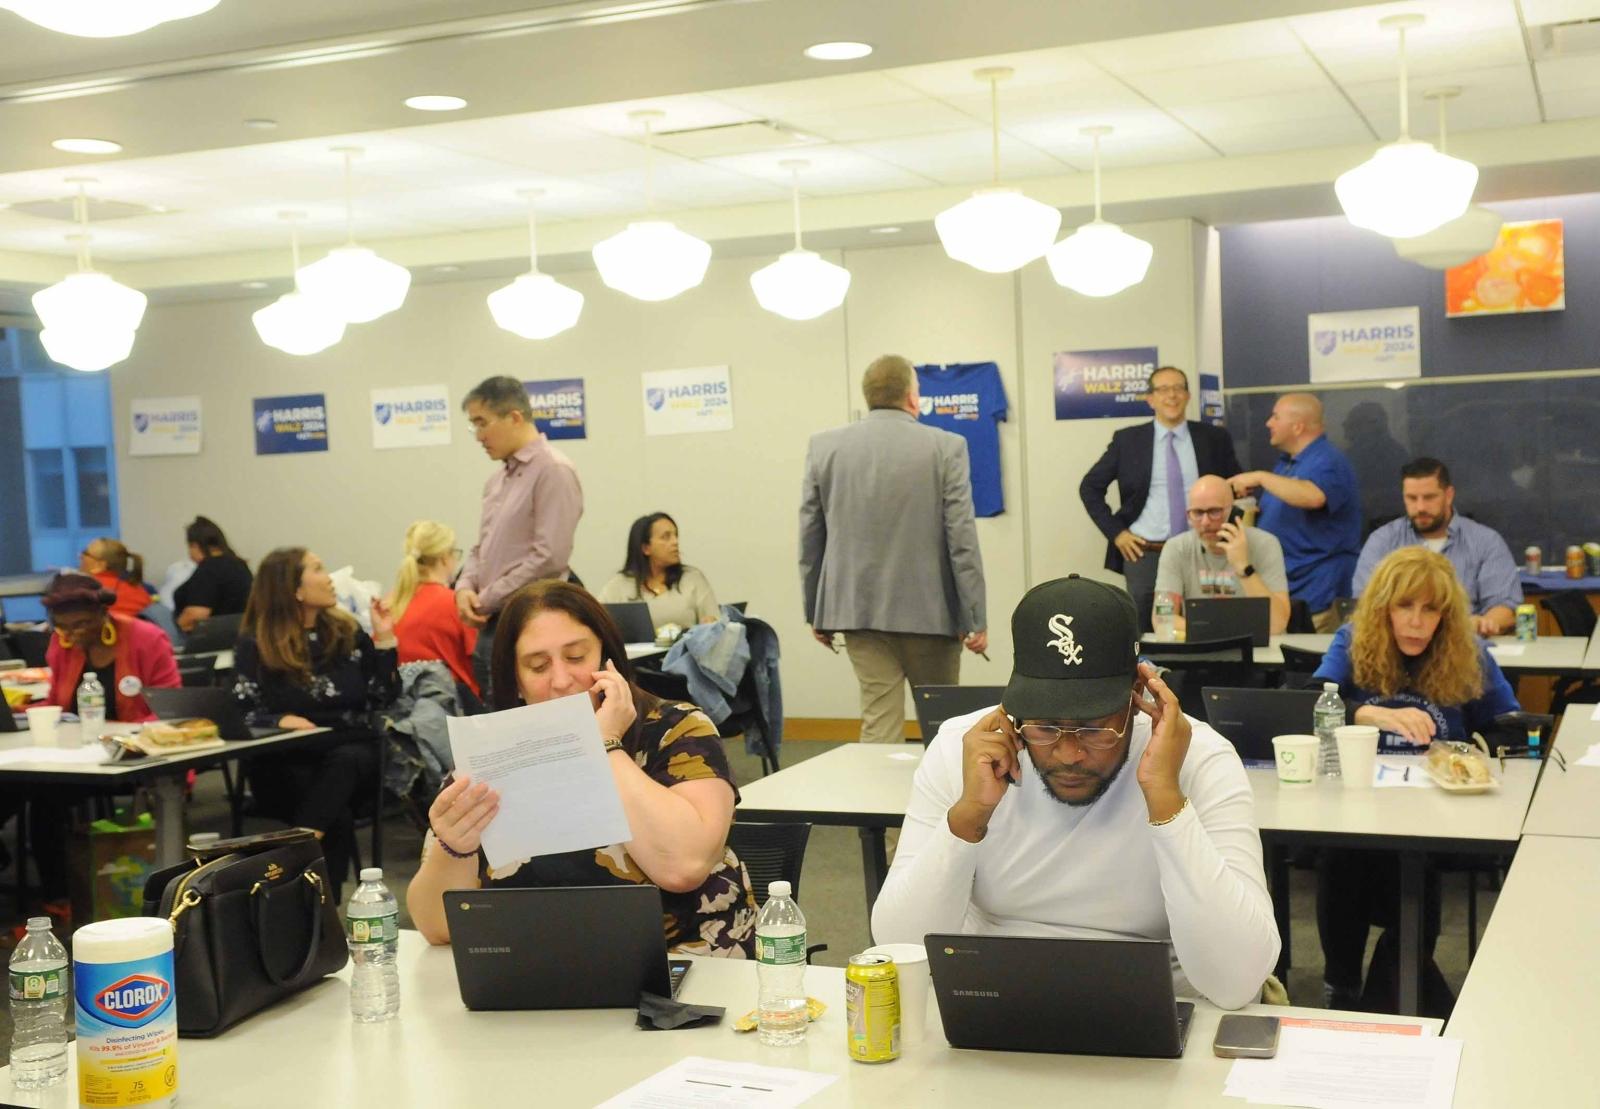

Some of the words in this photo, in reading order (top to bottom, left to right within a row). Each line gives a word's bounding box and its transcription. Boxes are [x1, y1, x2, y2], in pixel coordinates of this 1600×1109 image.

[1342, 324, 1414, 343] HARRIS
[1384, 341, 1415, 352] 2024
[1083, 363, 1154, 381] HARRIS
[668, 382, 728, 398] HARRIS
[1084, 381, 1122, 394] WALZ
[394, 399, 446, 414] HARRIS
[704, 397, 729, 407] 2024
[934, 394, 979, 407] HARRIS
[273, 406, 324, 422] HARRIS
[468, 946, 511, 954] SAMSUNG
[104, 983, 164, 1010] CLOROX
[952, 989, 1000, 998] SAMSUNG
[106, 1033, 146, 1044] Disinfecting
[101, 1043, 123, 1053] 99.9%
[132, 1080, 144, 1090] 75
